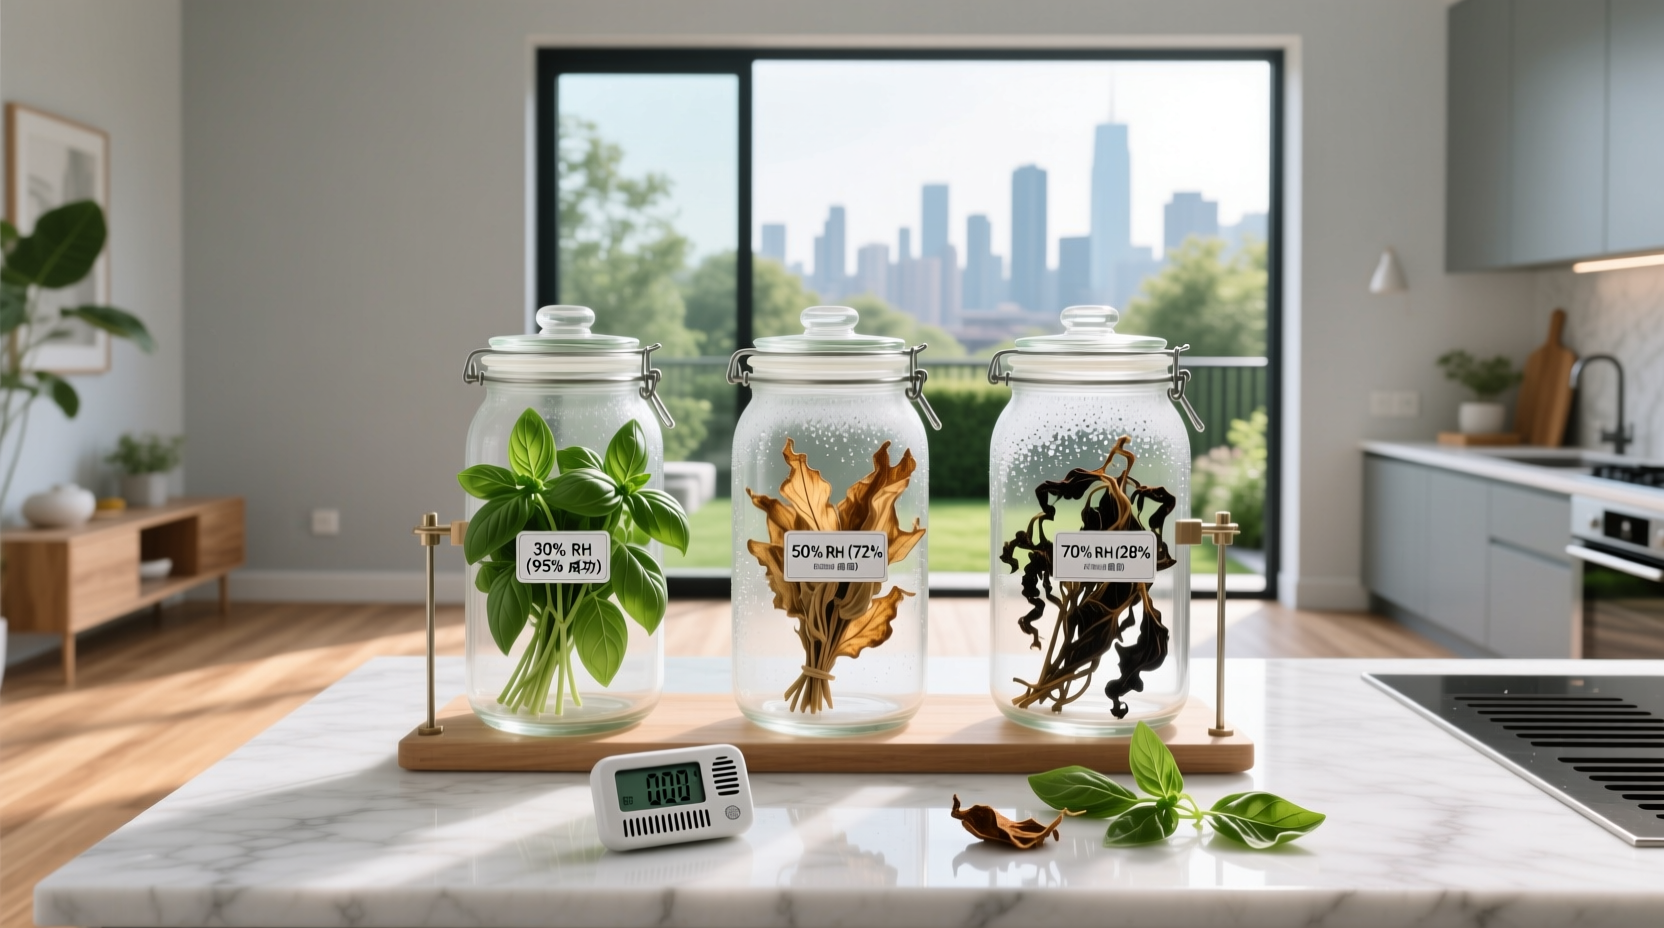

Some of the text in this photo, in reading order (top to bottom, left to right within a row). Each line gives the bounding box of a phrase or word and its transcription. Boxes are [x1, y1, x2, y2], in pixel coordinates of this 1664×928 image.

[533, 542, 592, 557] 30% RH
[792, 544, 883, 560] 50% RH (72%
[1061, 544, 1092, 559] 70%
[526, 557, 564, 575] (95%
